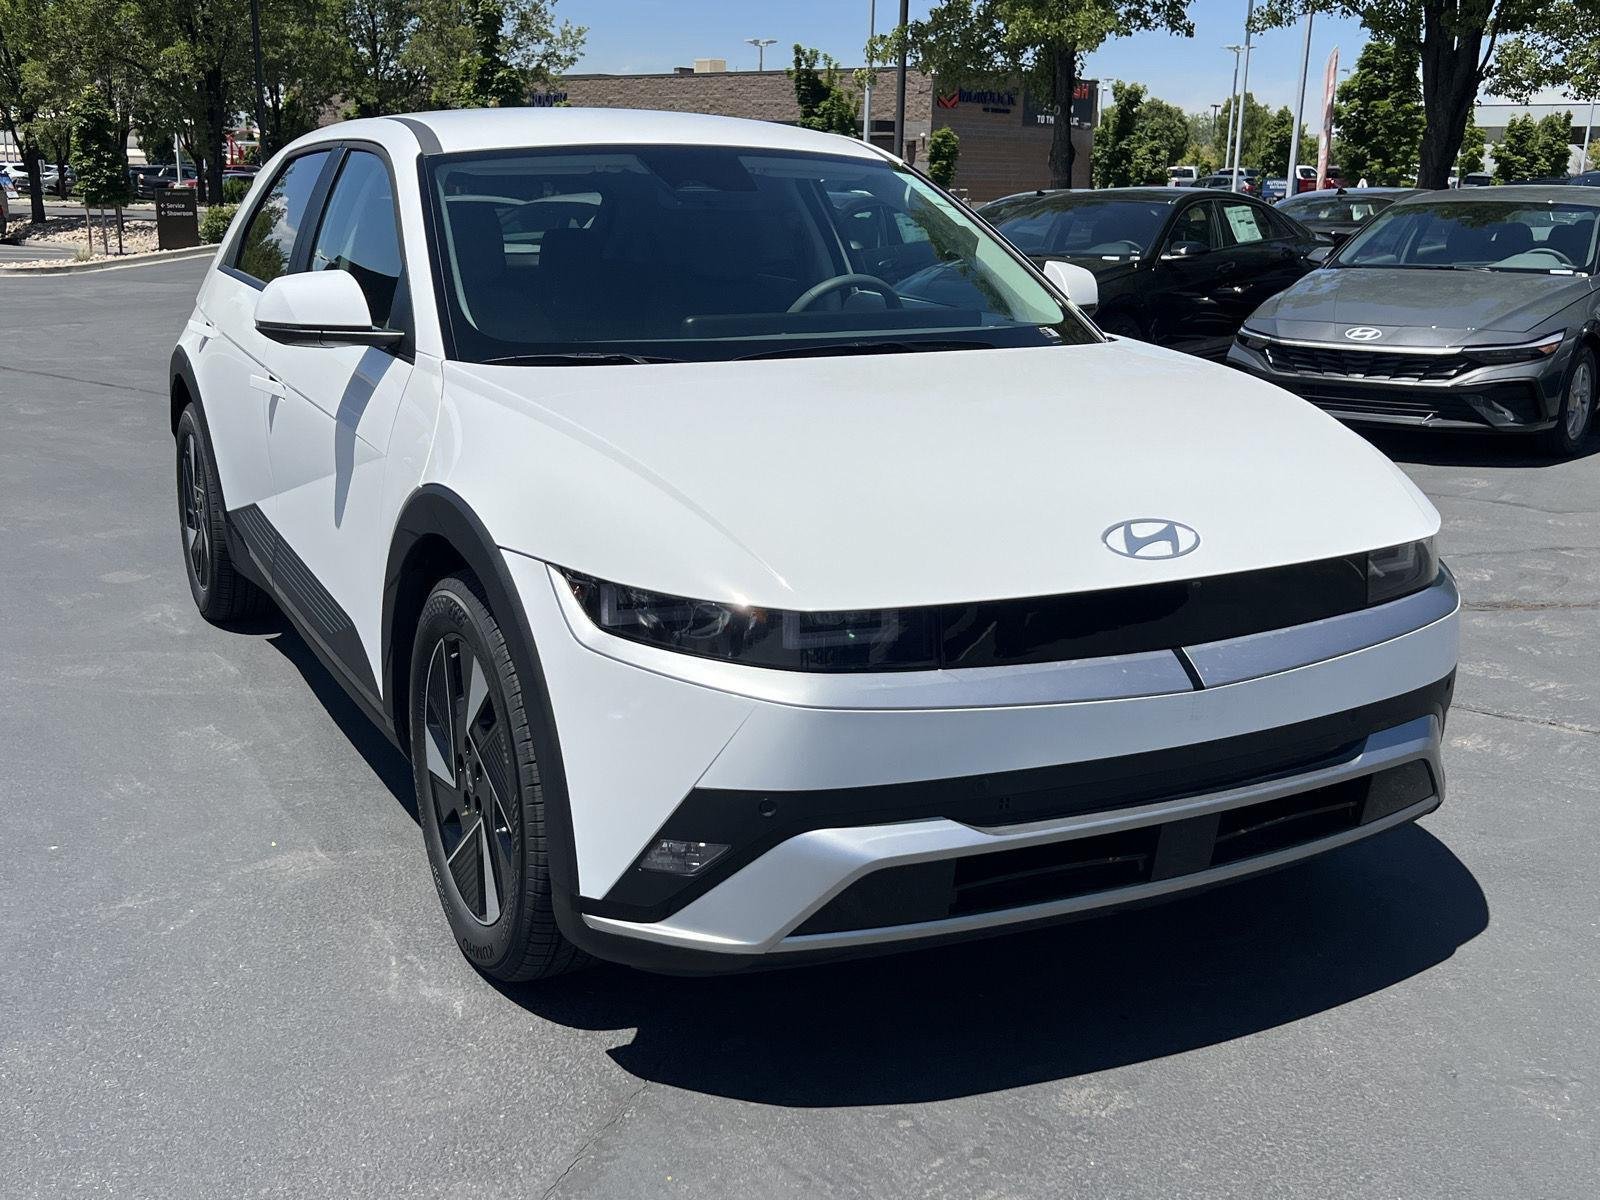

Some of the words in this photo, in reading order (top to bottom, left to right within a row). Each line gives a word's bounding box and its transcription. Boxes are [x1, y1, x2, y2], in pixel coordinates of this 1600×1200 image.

[1036, 114, 1045, 124] TO
[1045, 114, 1055, 125] TH
[462, 938, 495, 960] KUMHO
